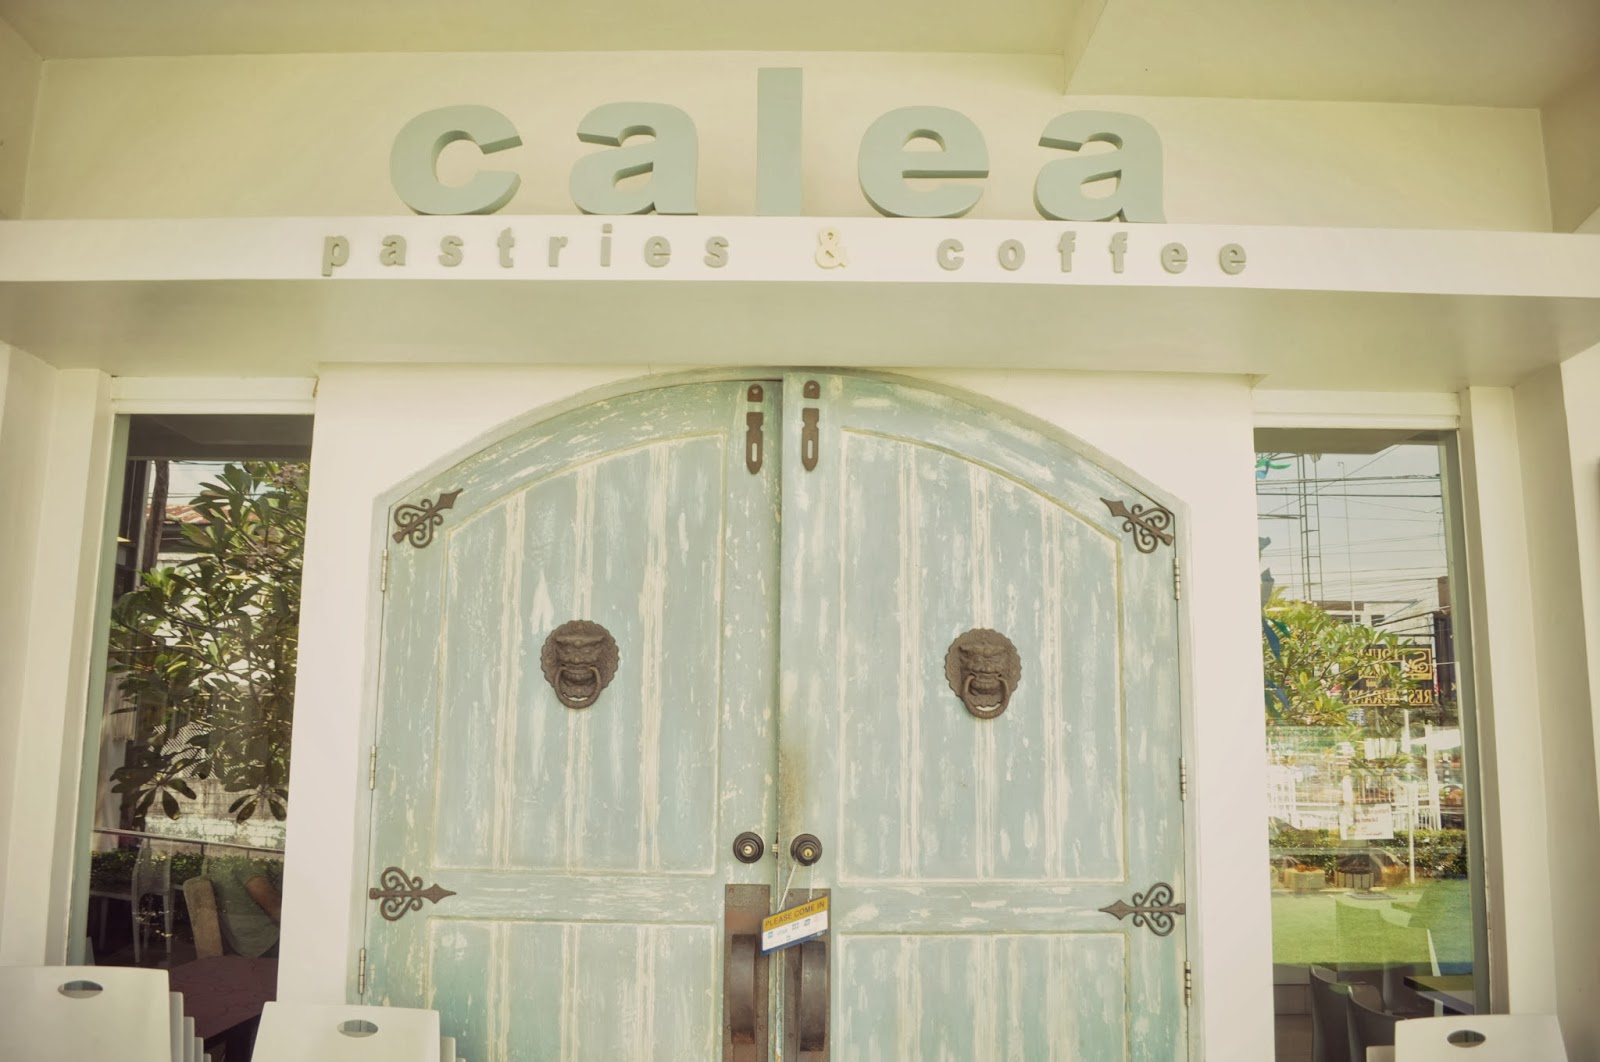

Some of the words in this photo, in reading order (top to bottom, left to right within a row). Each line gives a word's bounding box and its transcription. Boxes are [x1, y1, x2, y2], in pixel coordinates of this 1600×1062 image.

[389, 67, 1167, 224] calea
[322, 223, 729, 277] pastries
[815, 227, 848, 269] &
[937, 231, 1247, 275] coffee
[765, 913, 792, 927] PLEASE
[794, 905, 815, 917] COME
